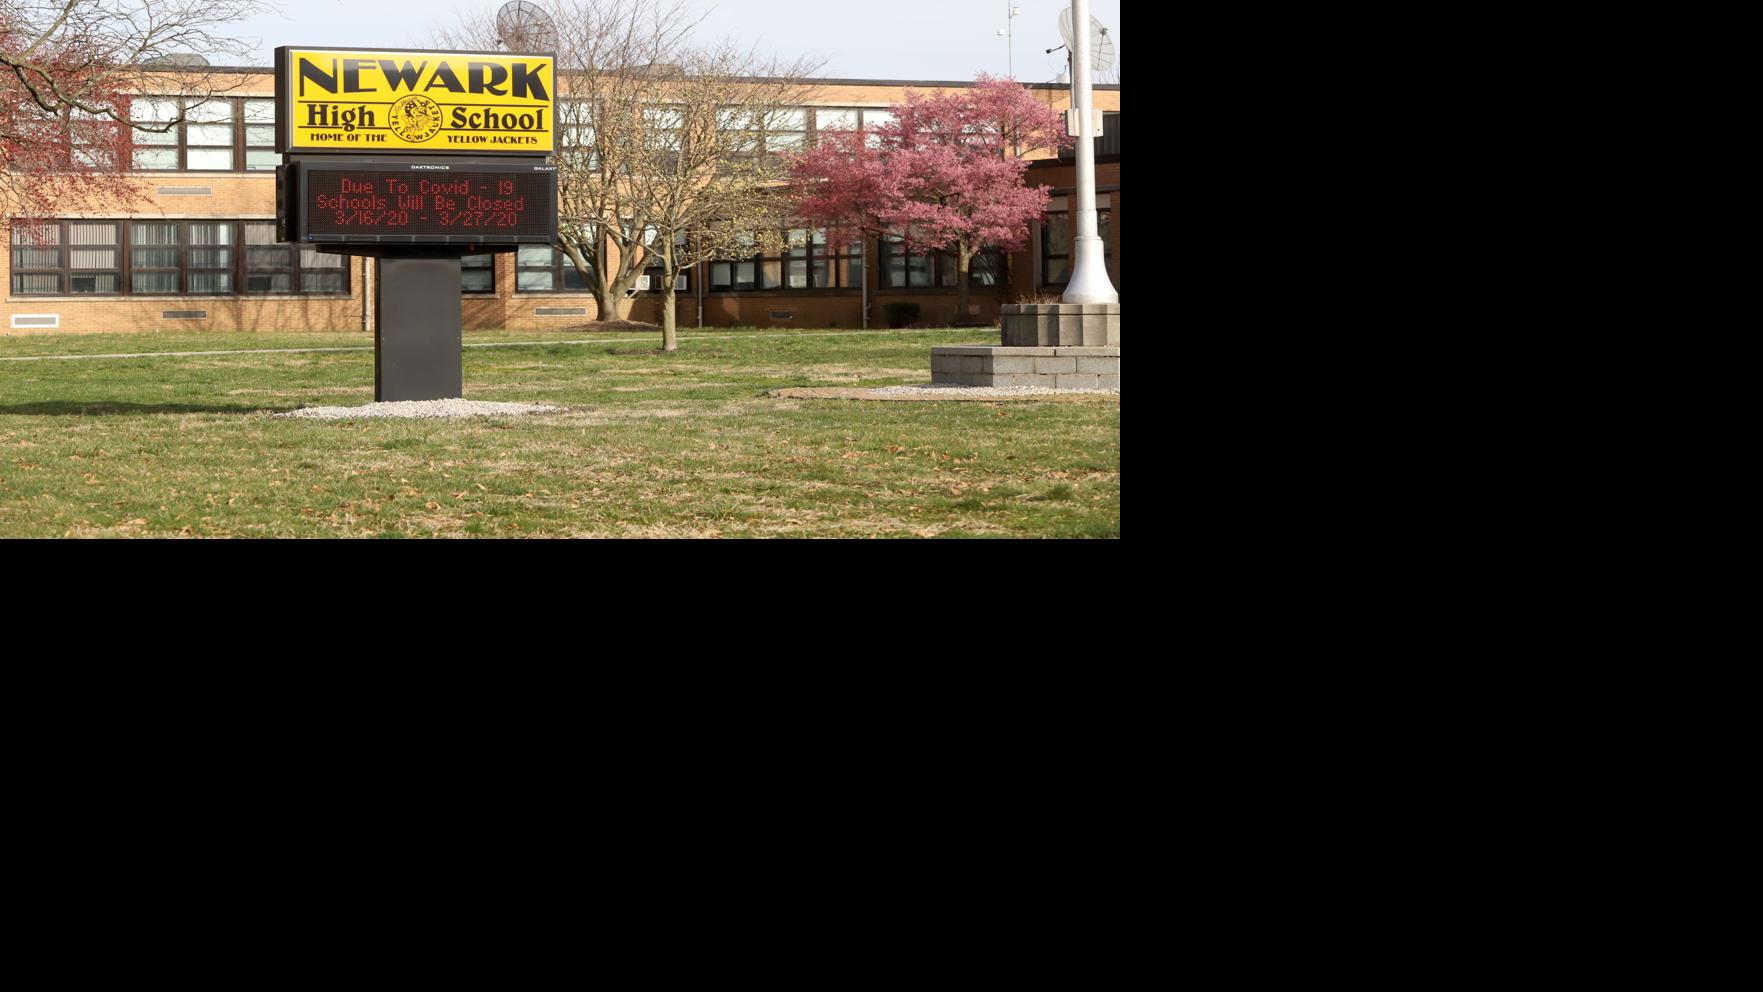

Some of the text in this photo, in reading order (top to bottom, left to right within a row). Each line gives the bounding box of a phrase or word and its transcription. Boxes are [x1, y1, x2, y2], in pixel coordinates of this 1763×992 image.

[299, 57, 550, 101] NEWARK
[307, 104, 543, 132] High School
[311, 133, 538, 145] HOME OF THE YELLOW JACKETS
[341, 178, 373, 194] Due
[385, 178, 408, 194] To
[420, 179, 468, 195] Covid
[499, 180, 513, 195] 19
[317, 193, 524, 211] Schools Will Be Closed
[336, 210, 408, 225] 3/16/20
[440, 211, 517, 226] 3/27/20
